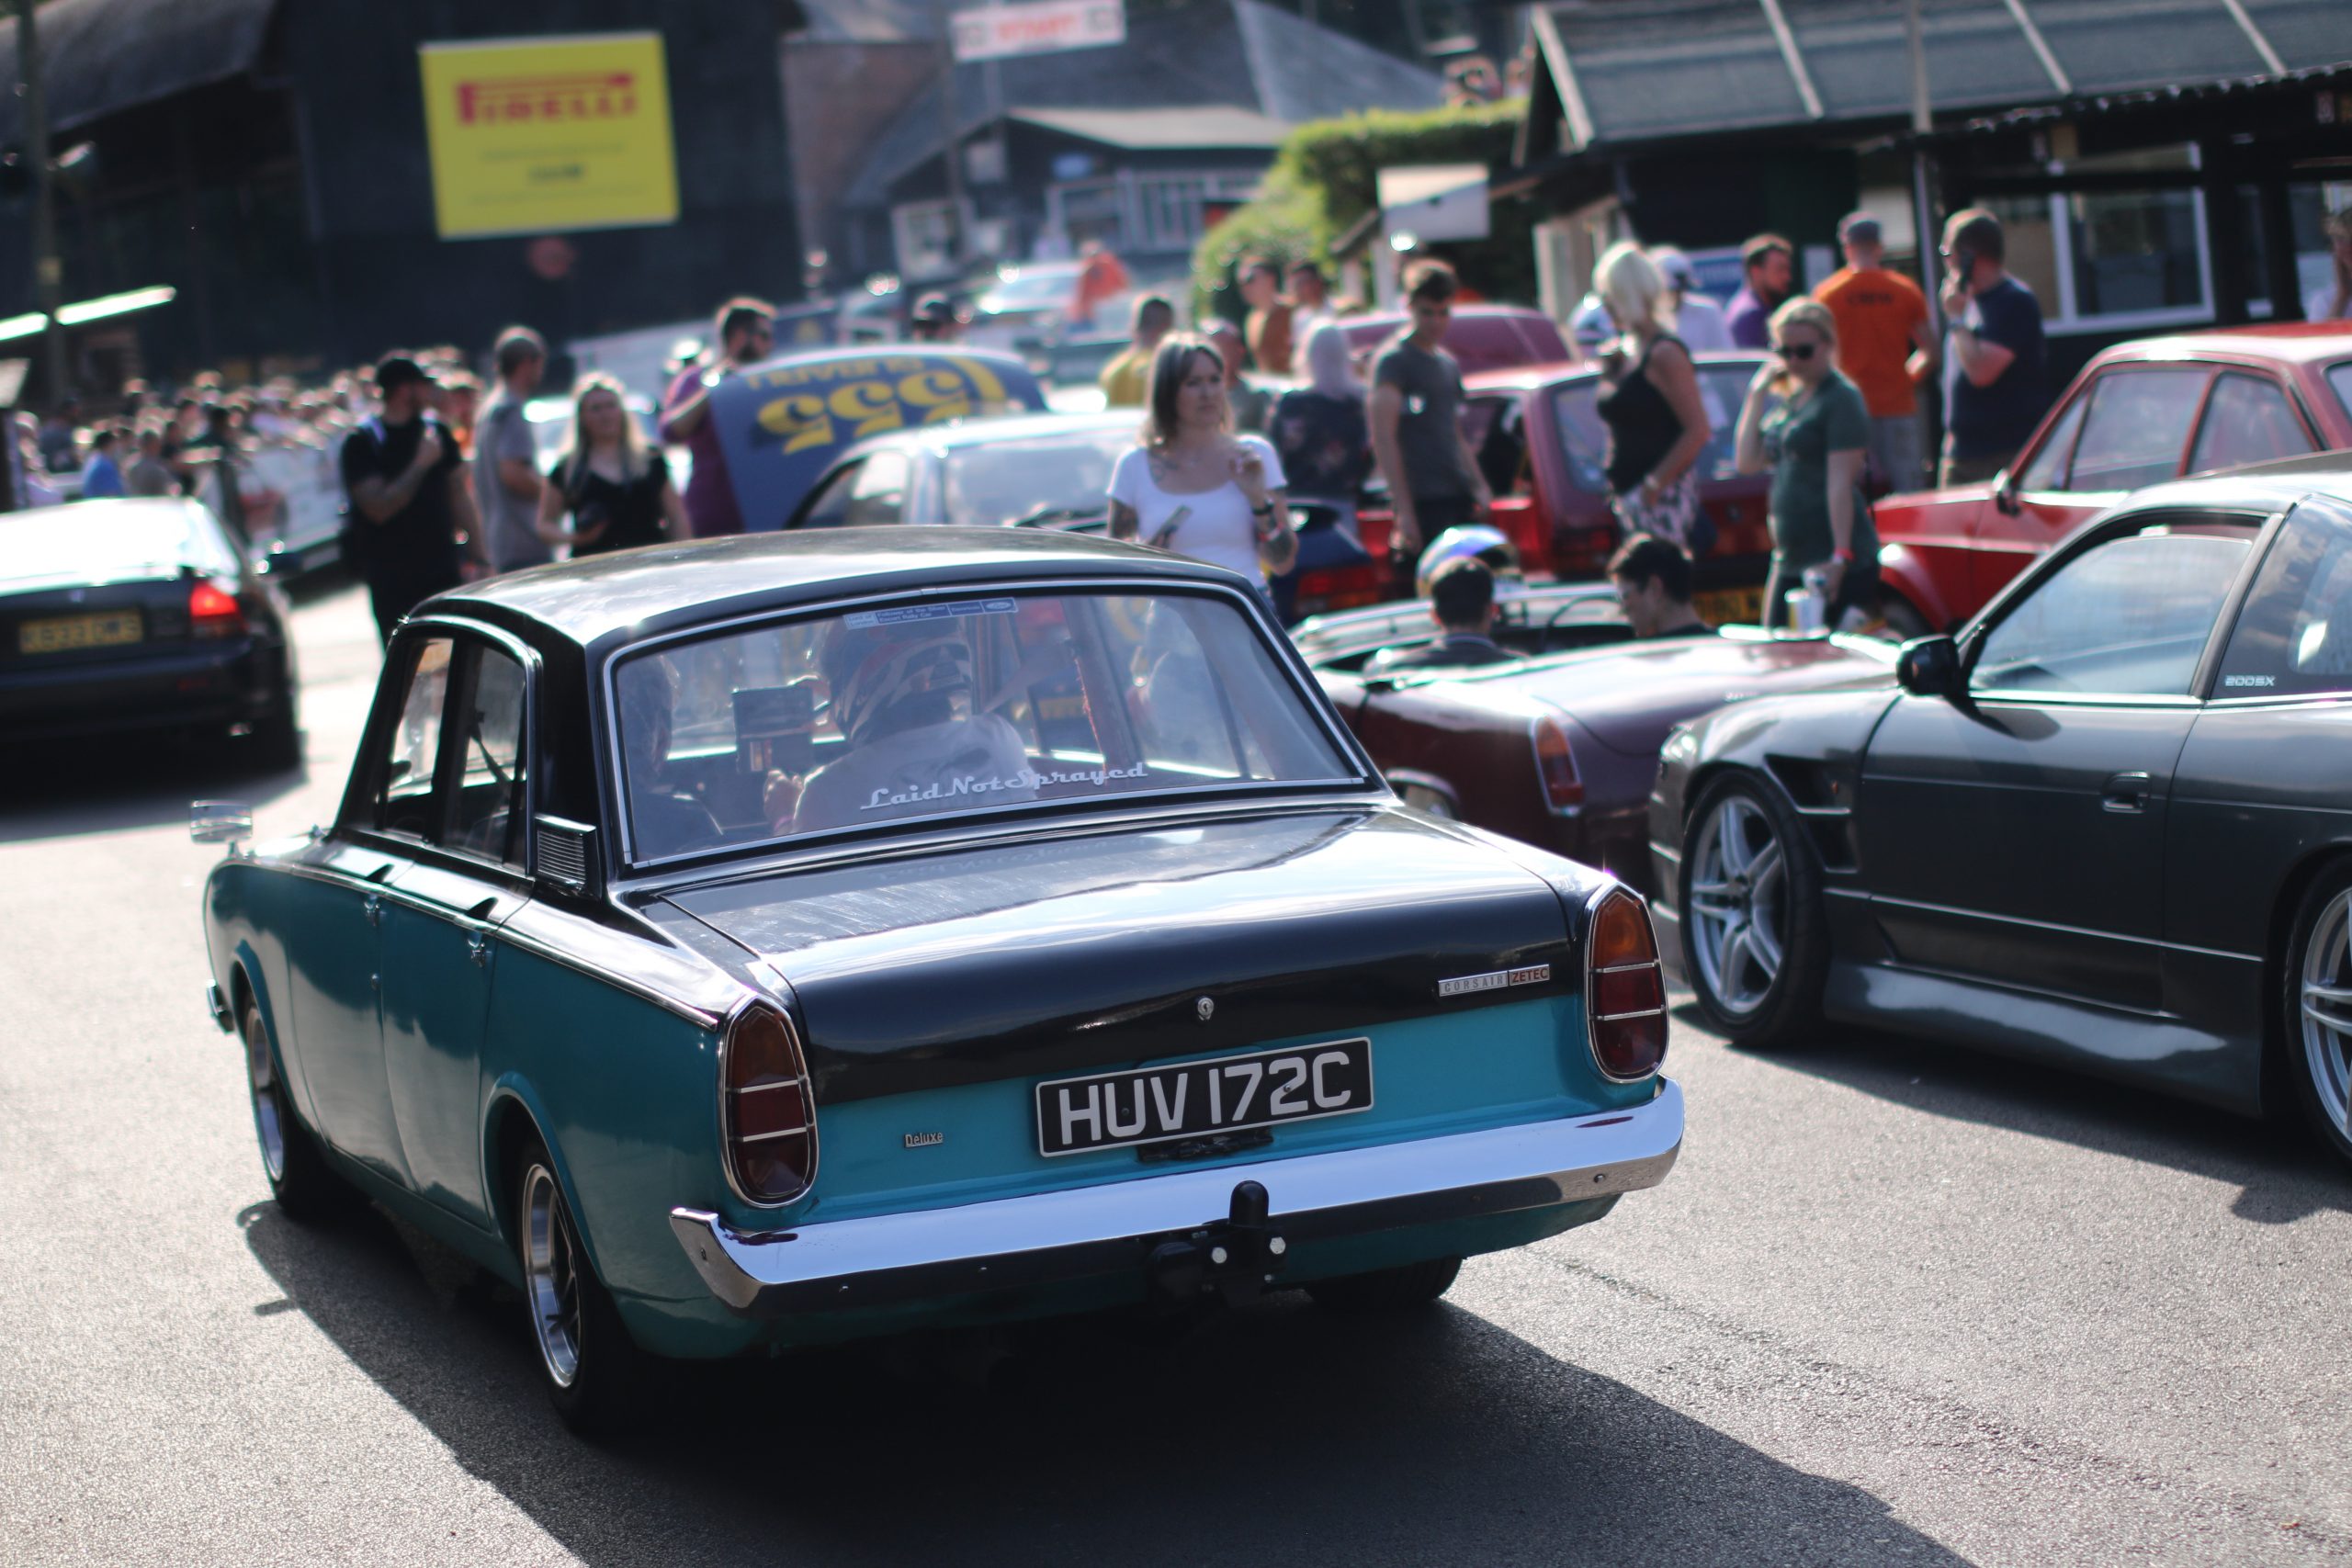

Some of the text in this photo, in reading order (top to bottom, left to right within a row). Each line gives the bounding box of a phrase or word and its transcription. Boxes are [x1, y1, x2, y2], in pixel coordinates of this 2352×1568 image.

[2225, 675, 2276, 687] 200SX
[860, 761, 1148, 810] Laid Not Sprayed
[1444, 967, 1549, 992] CORSAIR ZETEC
[1059, 1051, 1351, 1145] HUV 172C
[905, 1132, 944, 1147] Deluxe
